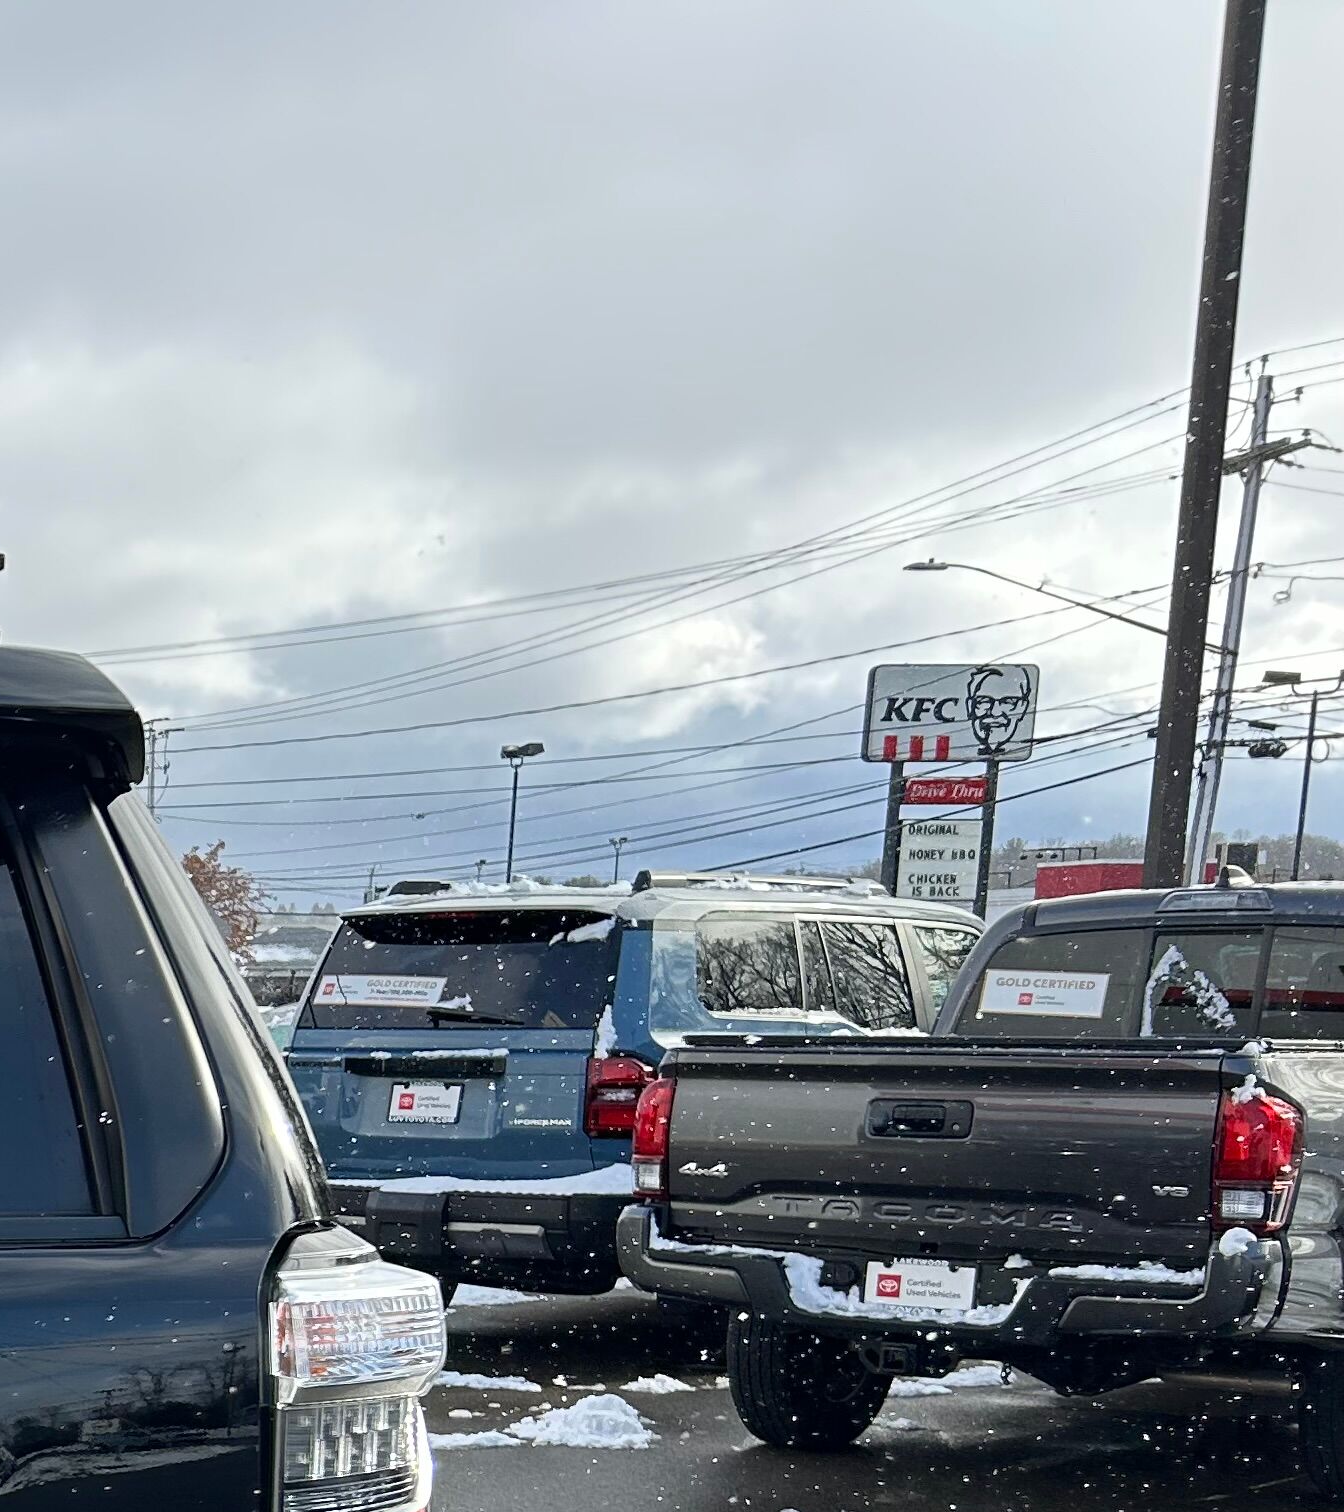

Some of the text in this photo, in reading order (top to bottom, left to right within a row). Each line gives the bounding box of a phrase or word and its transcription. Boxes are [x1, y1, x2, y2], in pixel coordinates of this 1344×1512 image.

[881, 697, 960, 723] KFC
[910, 783, 984, 799] Drive Thru
[908, 823, 960, 835] ORIGINAL
[908, 849, 976, 860] HONEY BBQ
[908, 873, 957, 884] CHICKEN
[912, 886, 960, 896] IS BACK
[367, 979, 438, 989] GOLD CERTIFIED
[996, 977, 1096, 990] GOLD CERTIFIED
[1152, 1185, 1189, 1197] V6
[771, 1194, 1084, 1232] TACOMA
[906, 1278, 942, 1288] Certified
[906, 1289, 961, 1299] Used Vehicles
